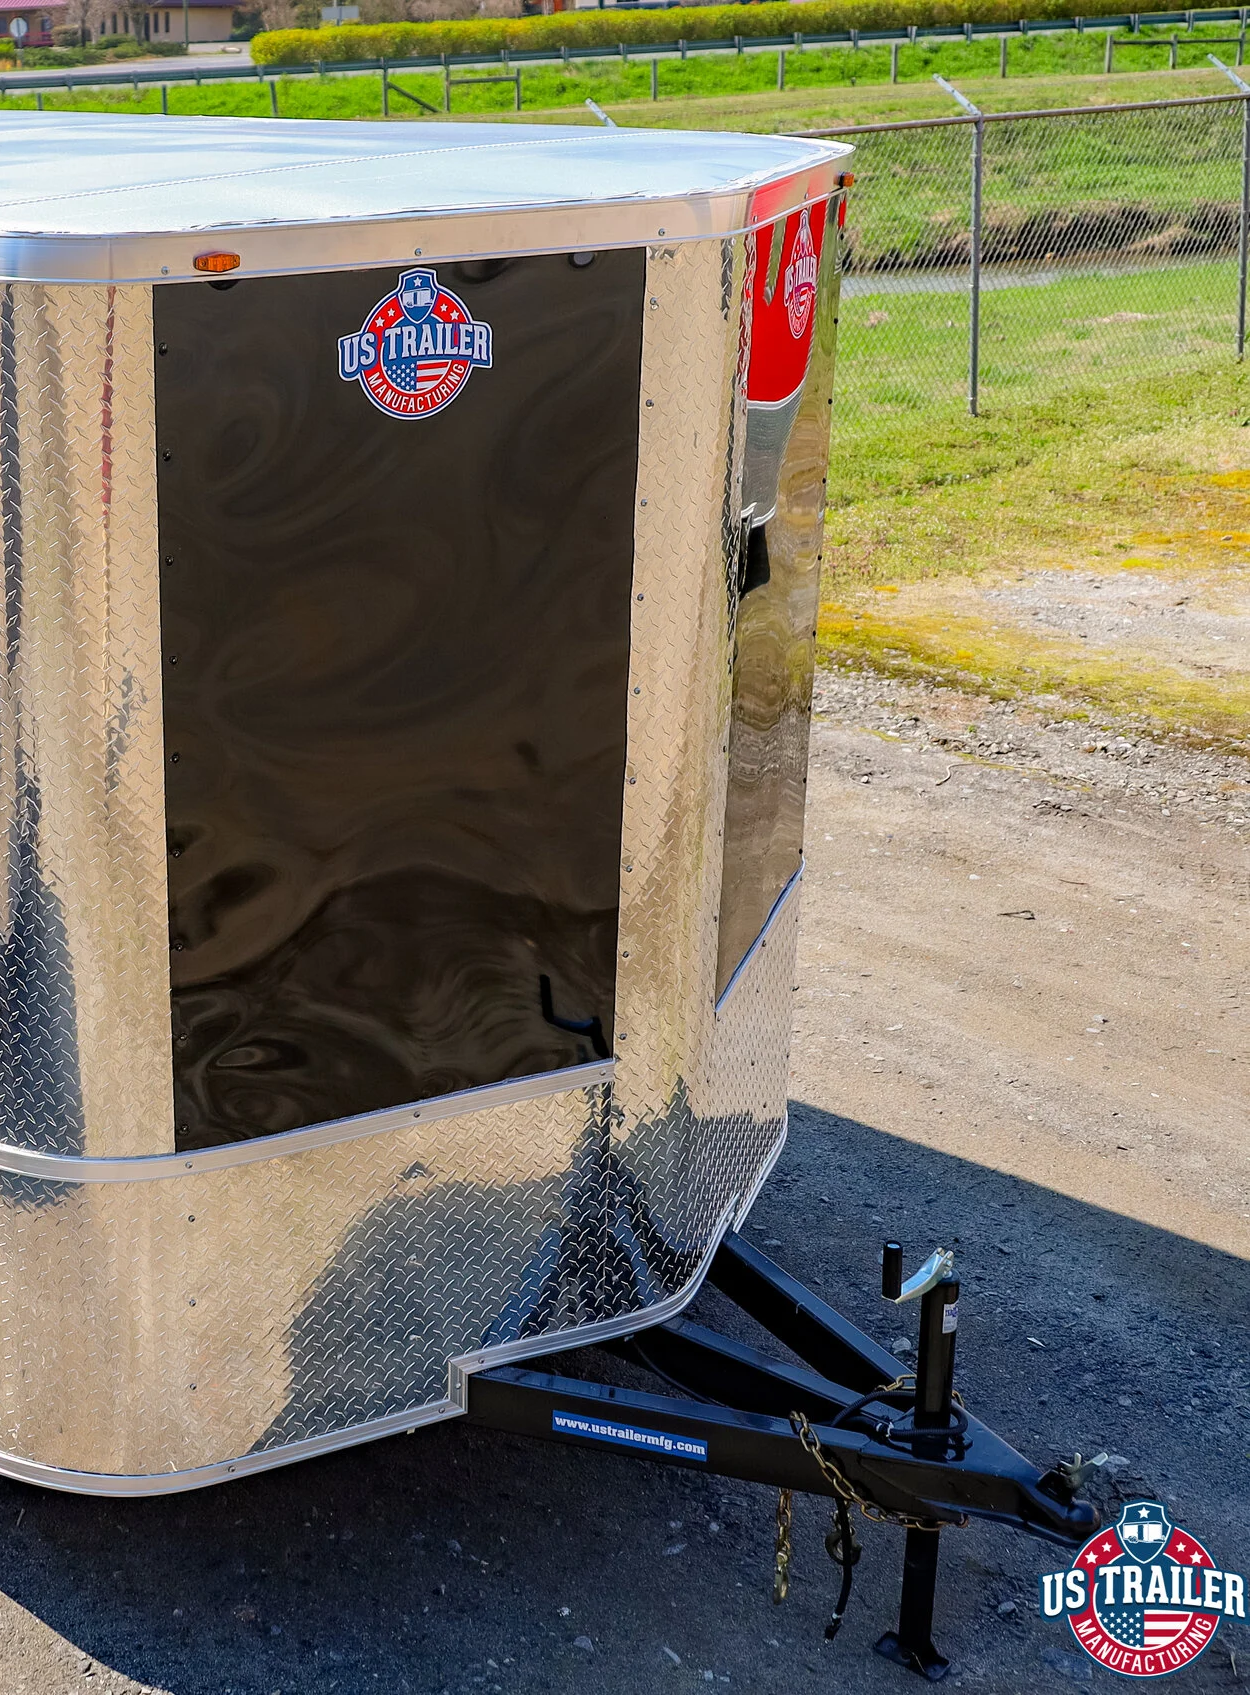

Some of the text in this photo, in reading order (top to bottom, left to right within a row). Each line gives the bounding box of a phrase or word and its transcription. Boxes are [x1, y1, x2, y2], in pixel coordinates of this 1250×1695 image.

[344, 323, 488, 373] US TRAILER
[367, 363, 465, 412] MANUFACTURING
[554, 1416, 706, 1455] www.ustrailermfg.com
